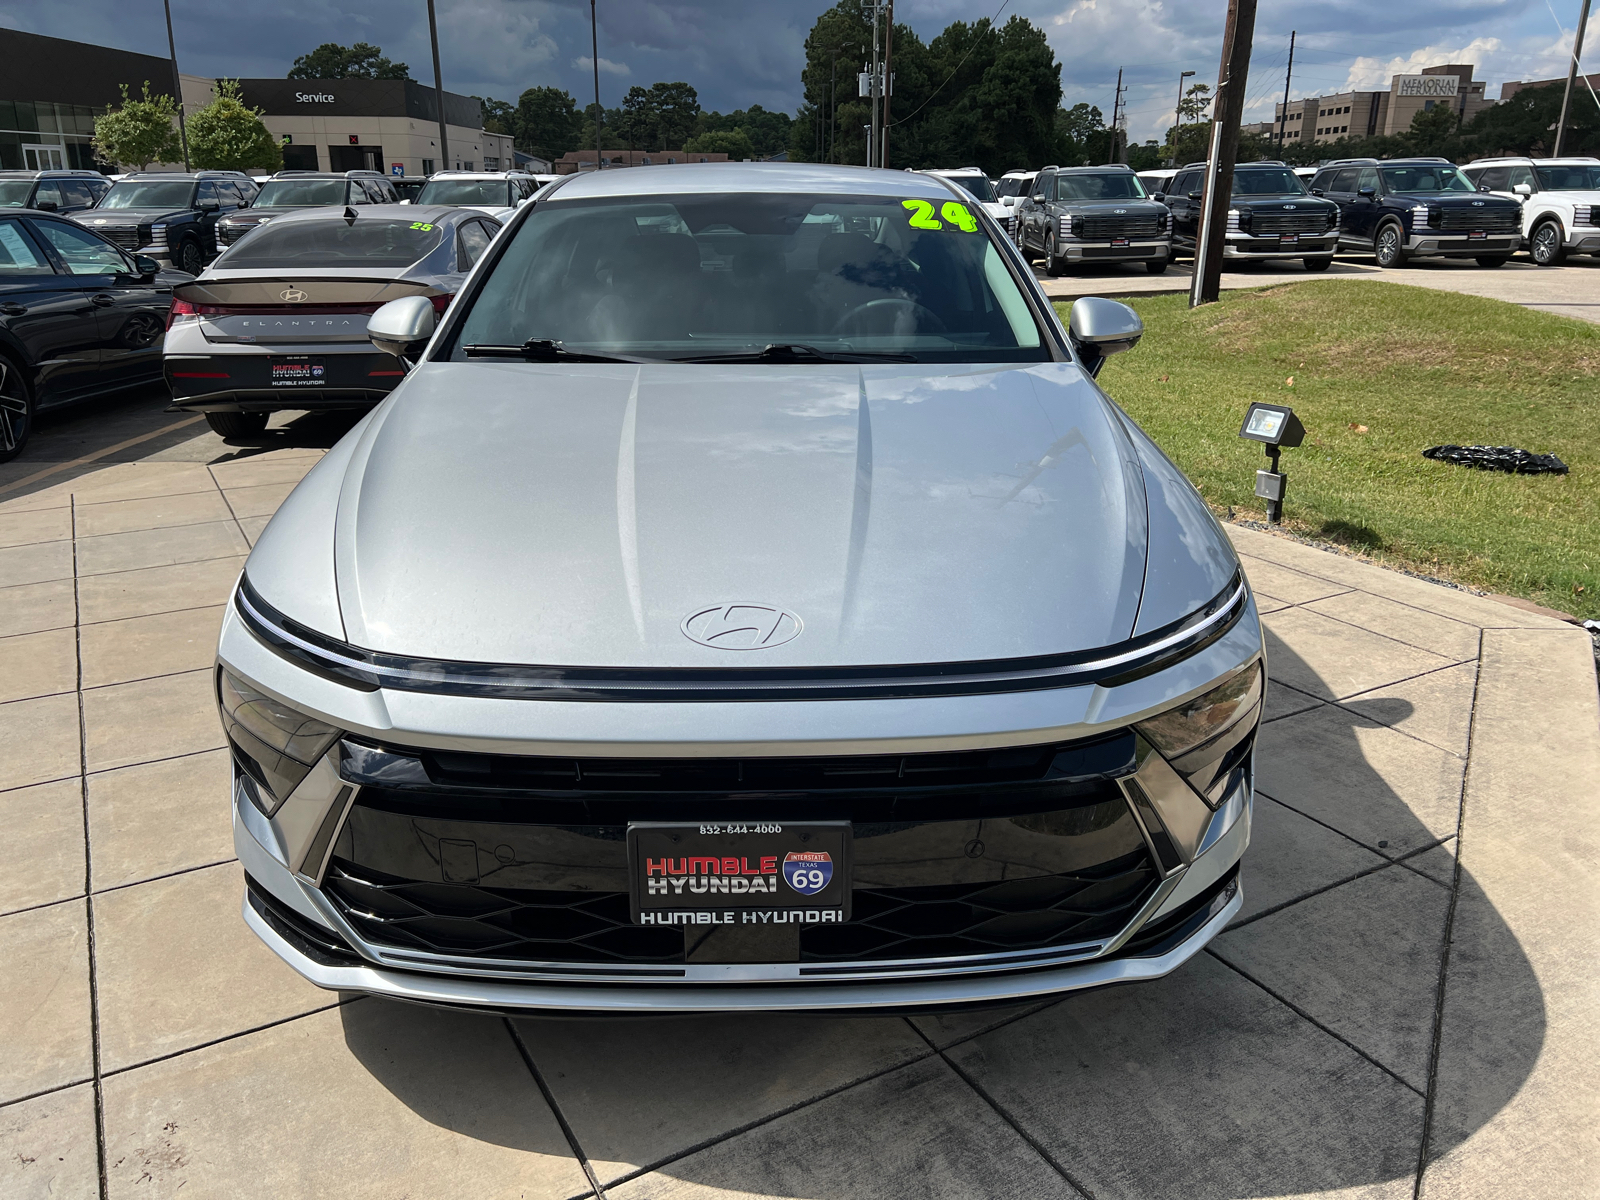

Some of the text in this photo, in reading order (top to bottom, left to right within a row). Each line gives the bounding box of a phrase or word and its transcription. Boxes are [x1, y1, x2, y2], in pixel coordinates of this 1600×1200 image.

[1402, 79, 1456, 88] MEMORIAL
[1401, 86, 1455, 95] HERMANN
[295, 92, 335, 103] Service
[901, 200, 978, 233] 24
[409, 222, 433, 232] 25
[272, 370, 310, 378] HYUNDAI
[699, 823, 782, 835] 832-644-4000
[646, 856, 778, 876] HUMBLE
[647, 875, 777, 895] HYUNDAI
[791, 869, 825, 889] 69
[640, 910, 843, 925] HUMBLE HYUNDAI
